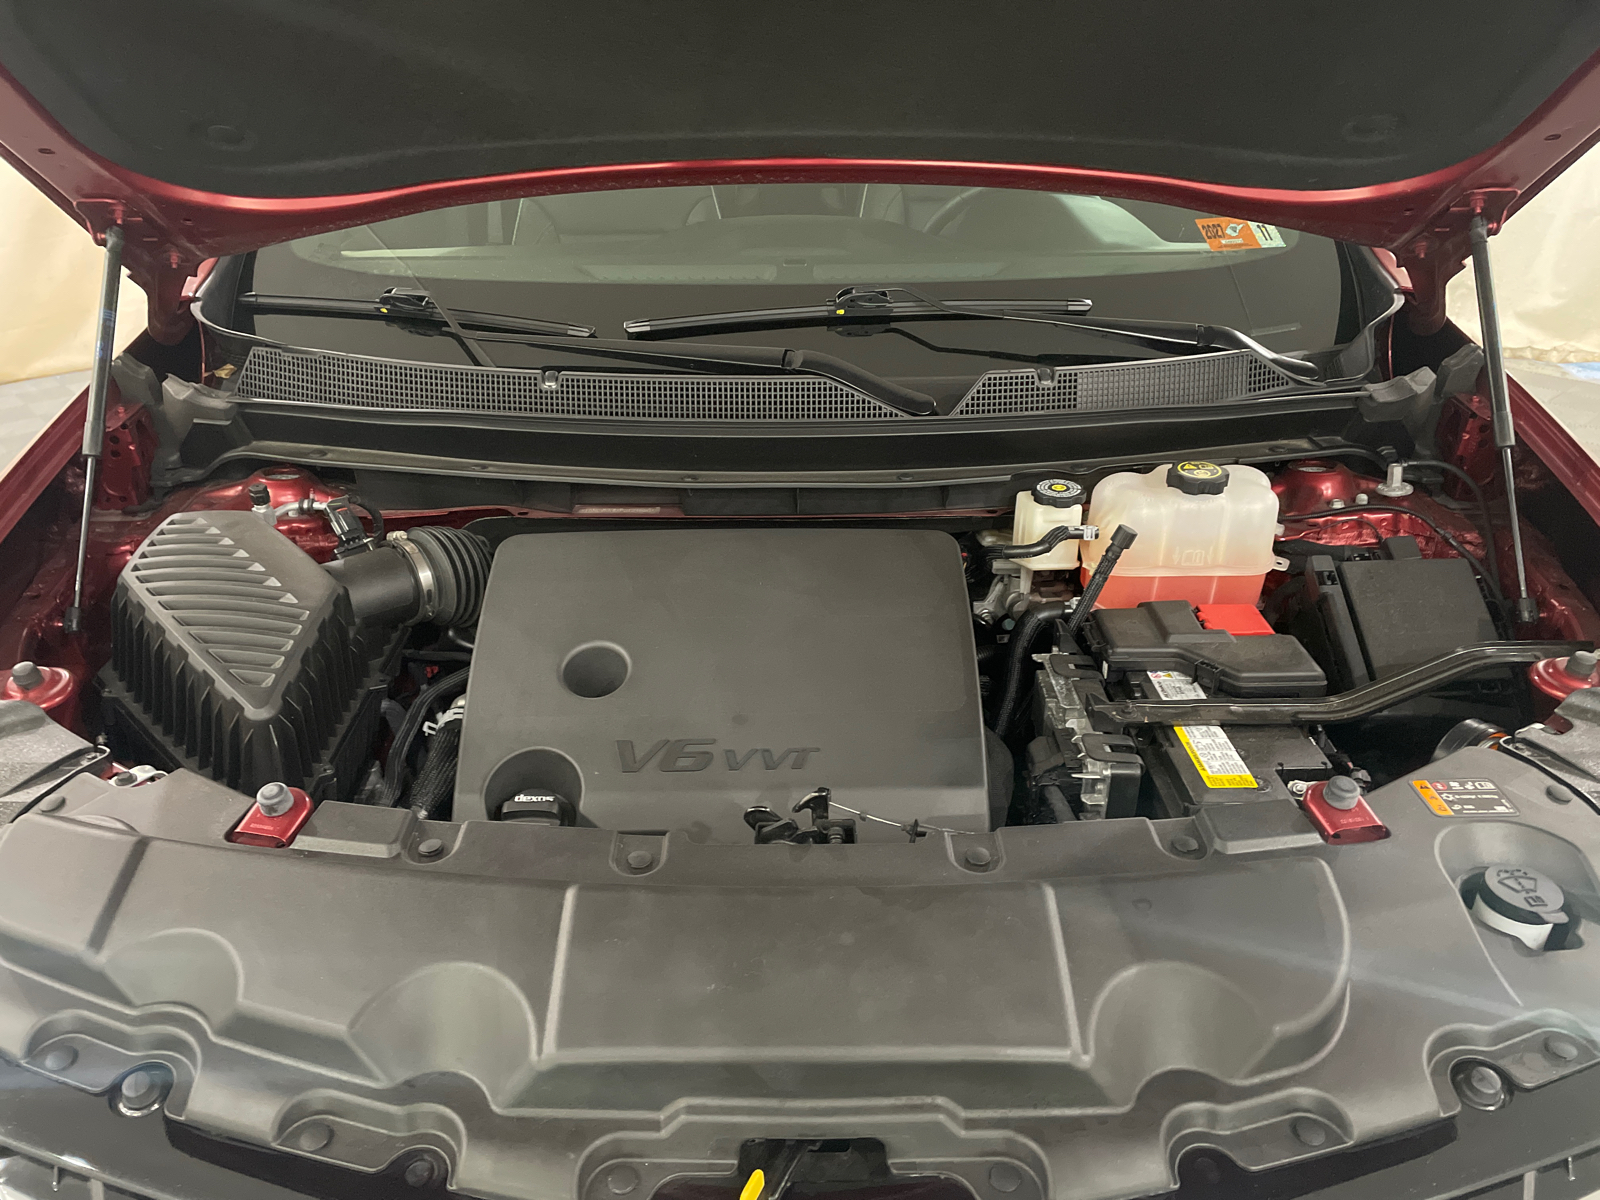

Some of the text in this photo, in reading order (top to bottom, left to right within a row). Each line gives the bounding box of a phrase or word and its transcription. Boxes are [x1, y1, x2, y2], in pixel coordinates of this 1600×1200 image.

[1201, 223, 1273, 241] 2027 11
[616, 738, 820, 773] V6 VVT
[514, 794, 555, 802] dexos
